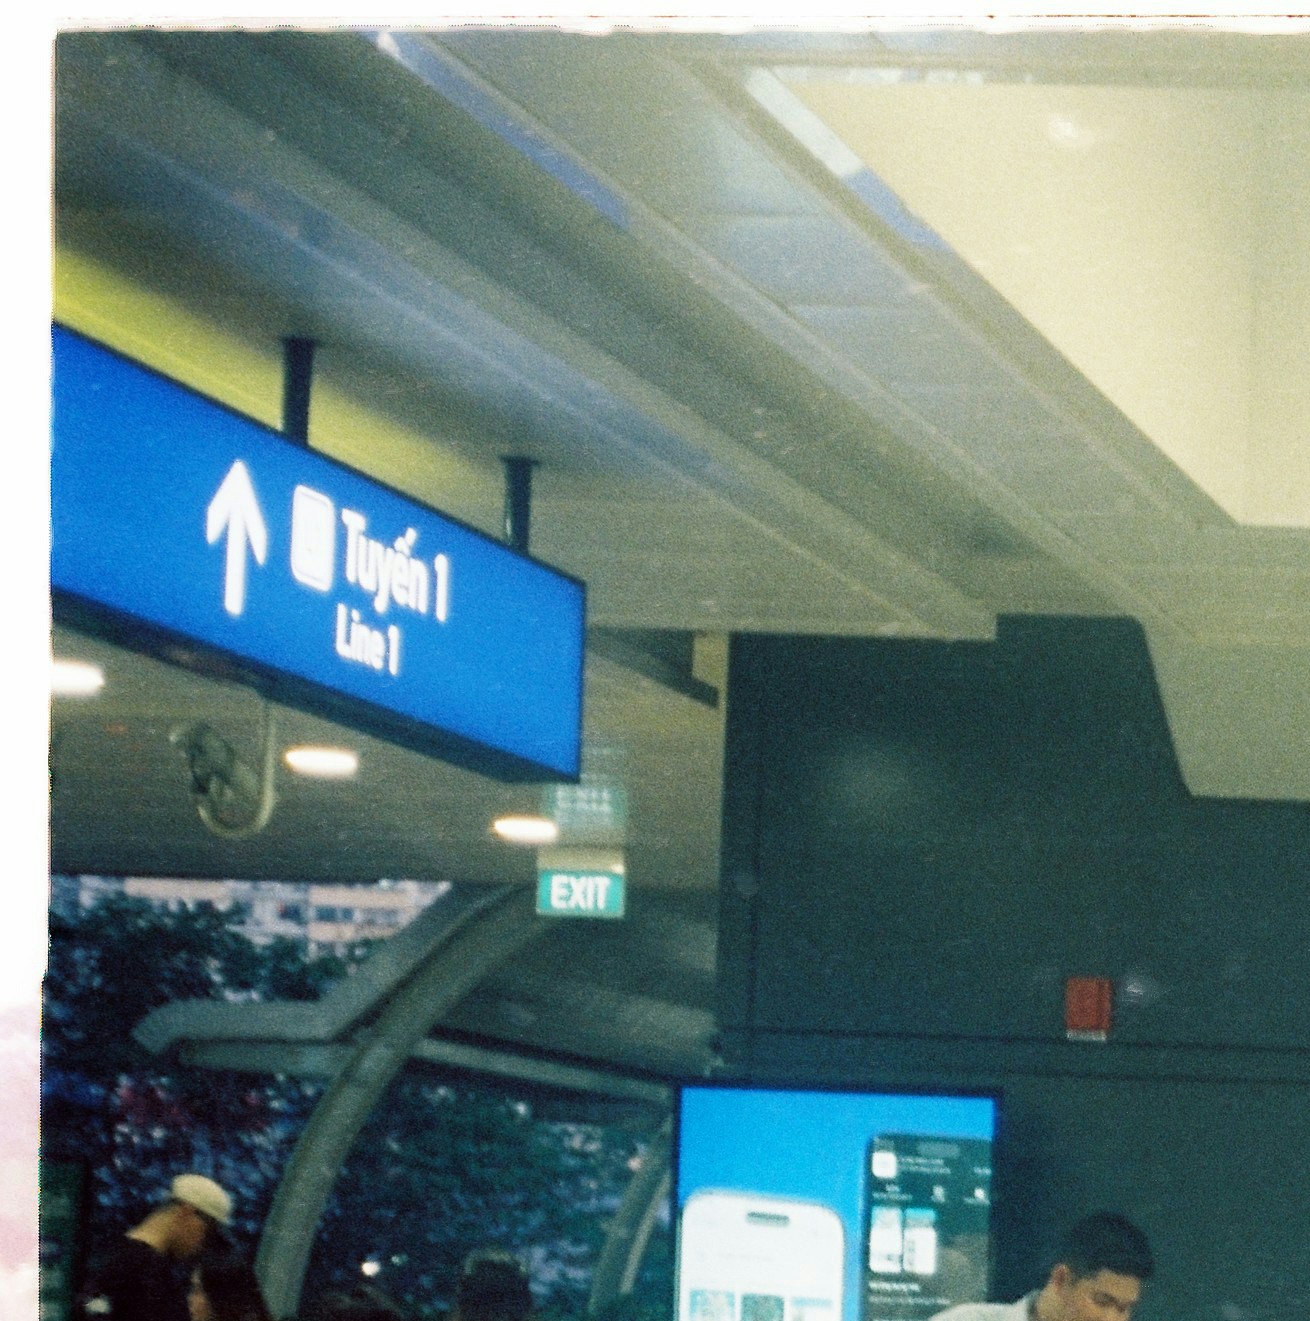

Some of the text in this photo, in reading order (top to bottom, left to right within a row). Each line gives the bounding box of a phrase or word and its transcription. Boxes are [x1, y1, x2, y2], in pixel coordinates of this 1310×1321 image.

[341, 508, 449, 623] Tuyến 1
[336, 602, 399, 677] Line 1
[551, 874, 611, 910] EXIT
